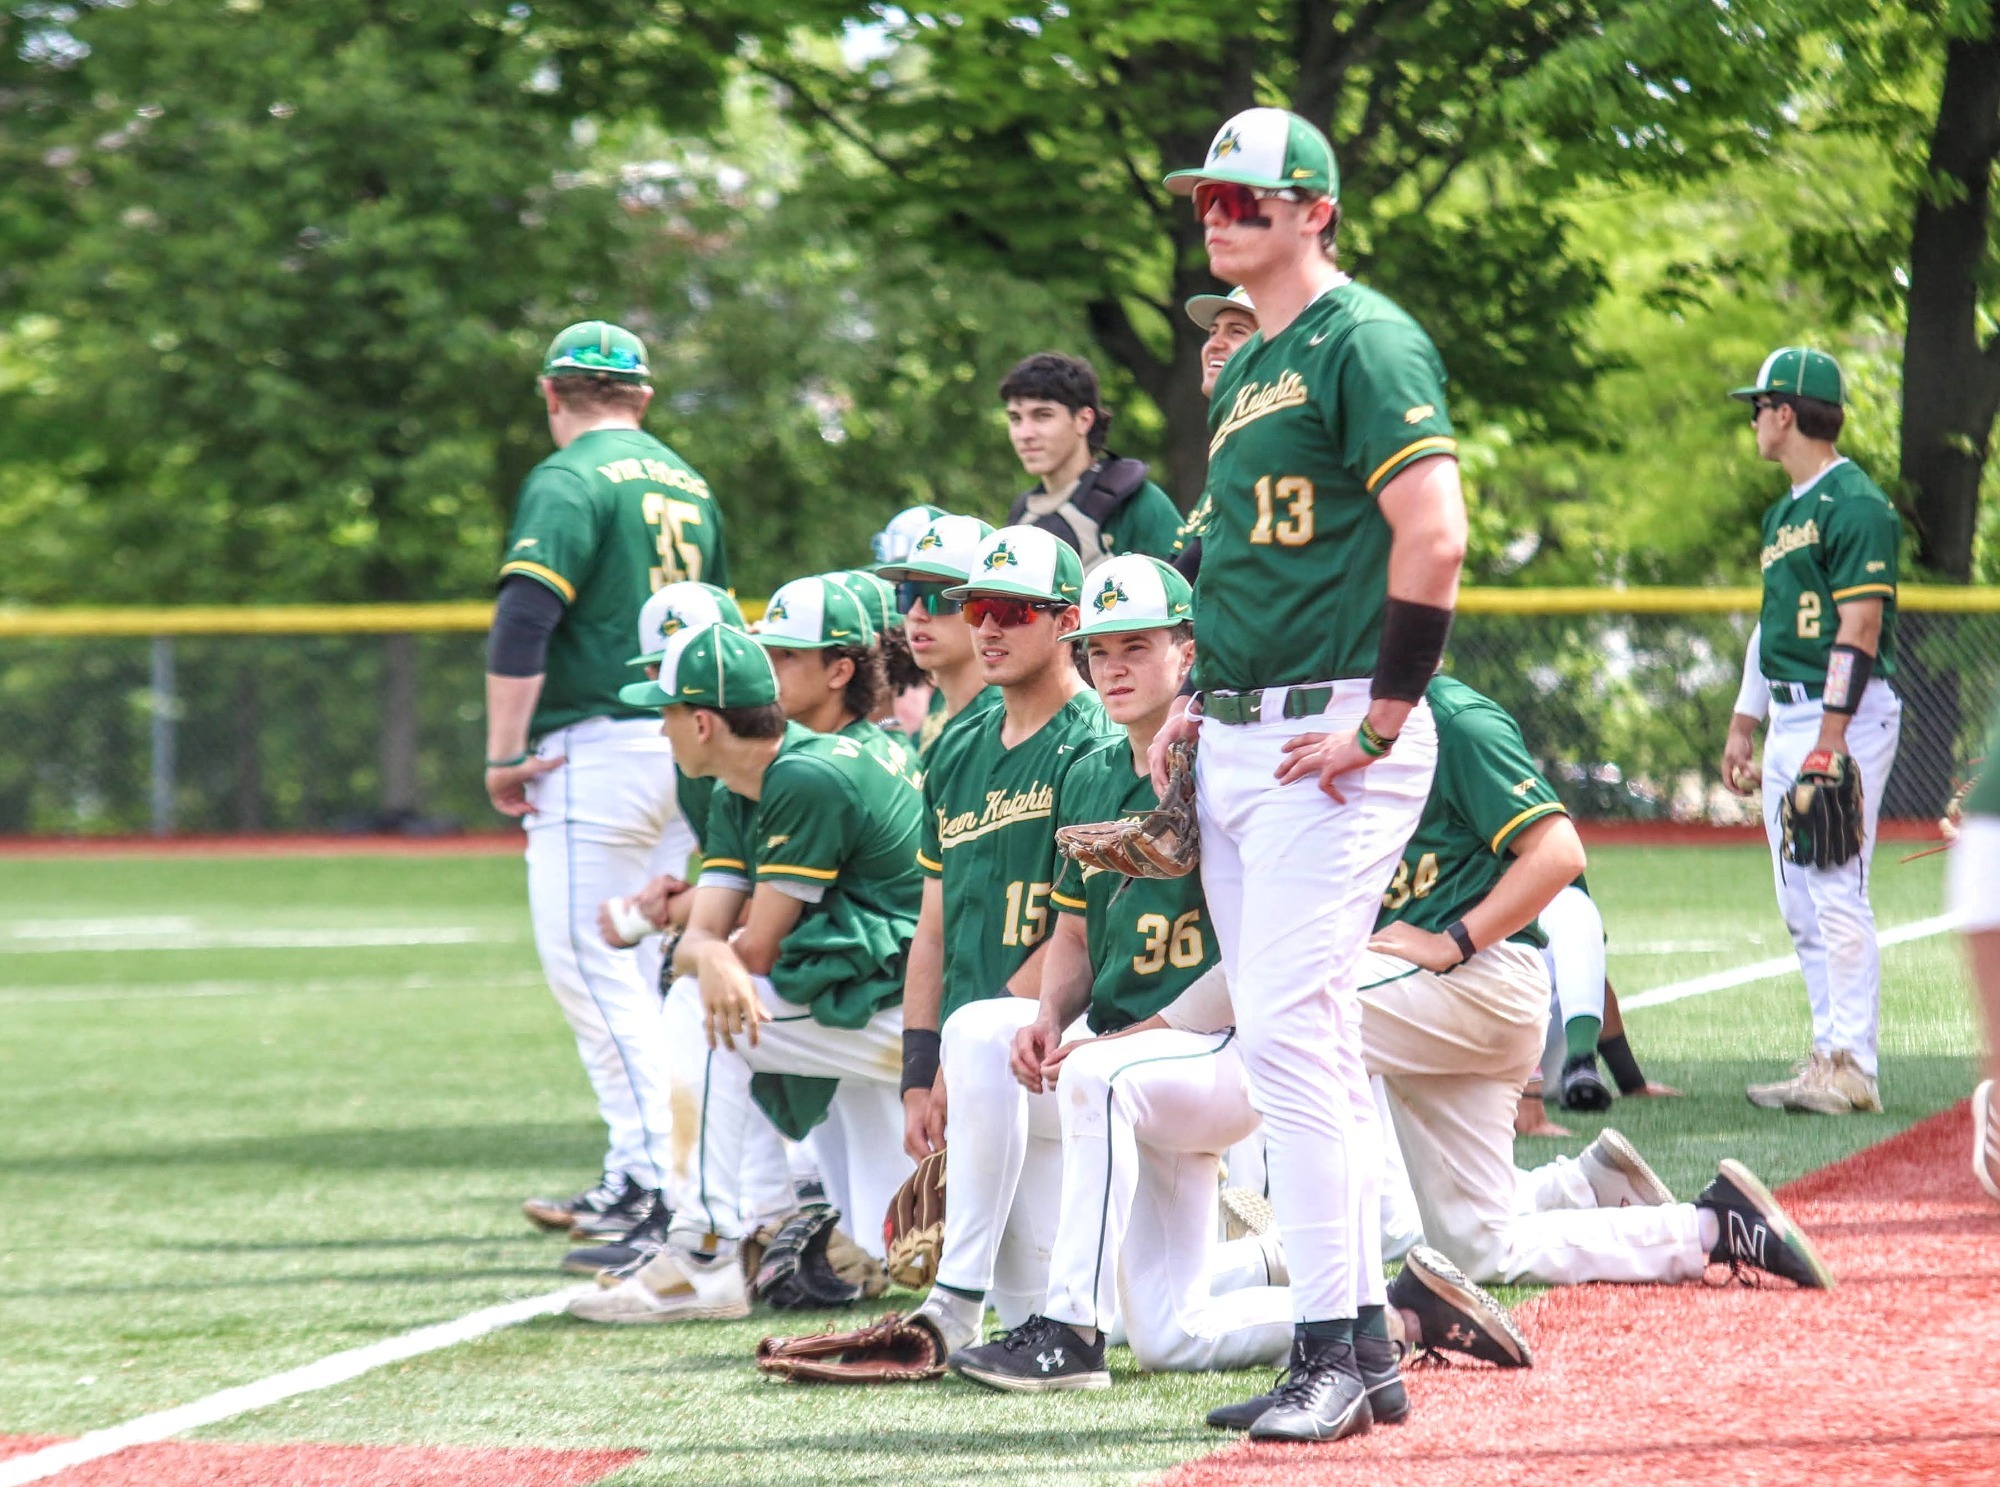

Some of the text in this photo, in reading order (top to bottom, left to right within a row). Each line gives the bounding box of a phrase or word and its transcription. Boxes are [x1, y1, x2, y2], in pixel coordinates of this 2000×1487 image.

[1228, 369, 1308, 421] Knights
[642, 492, 702, 595] 35
[1250, 475, 1315, 546] 13
[1797, 591, 1821, 639] 2
[979, 780, 1053, 826] Knights
[1002, 880, 1051, 947] 15
[1133, 909, 1204, 975] 36
